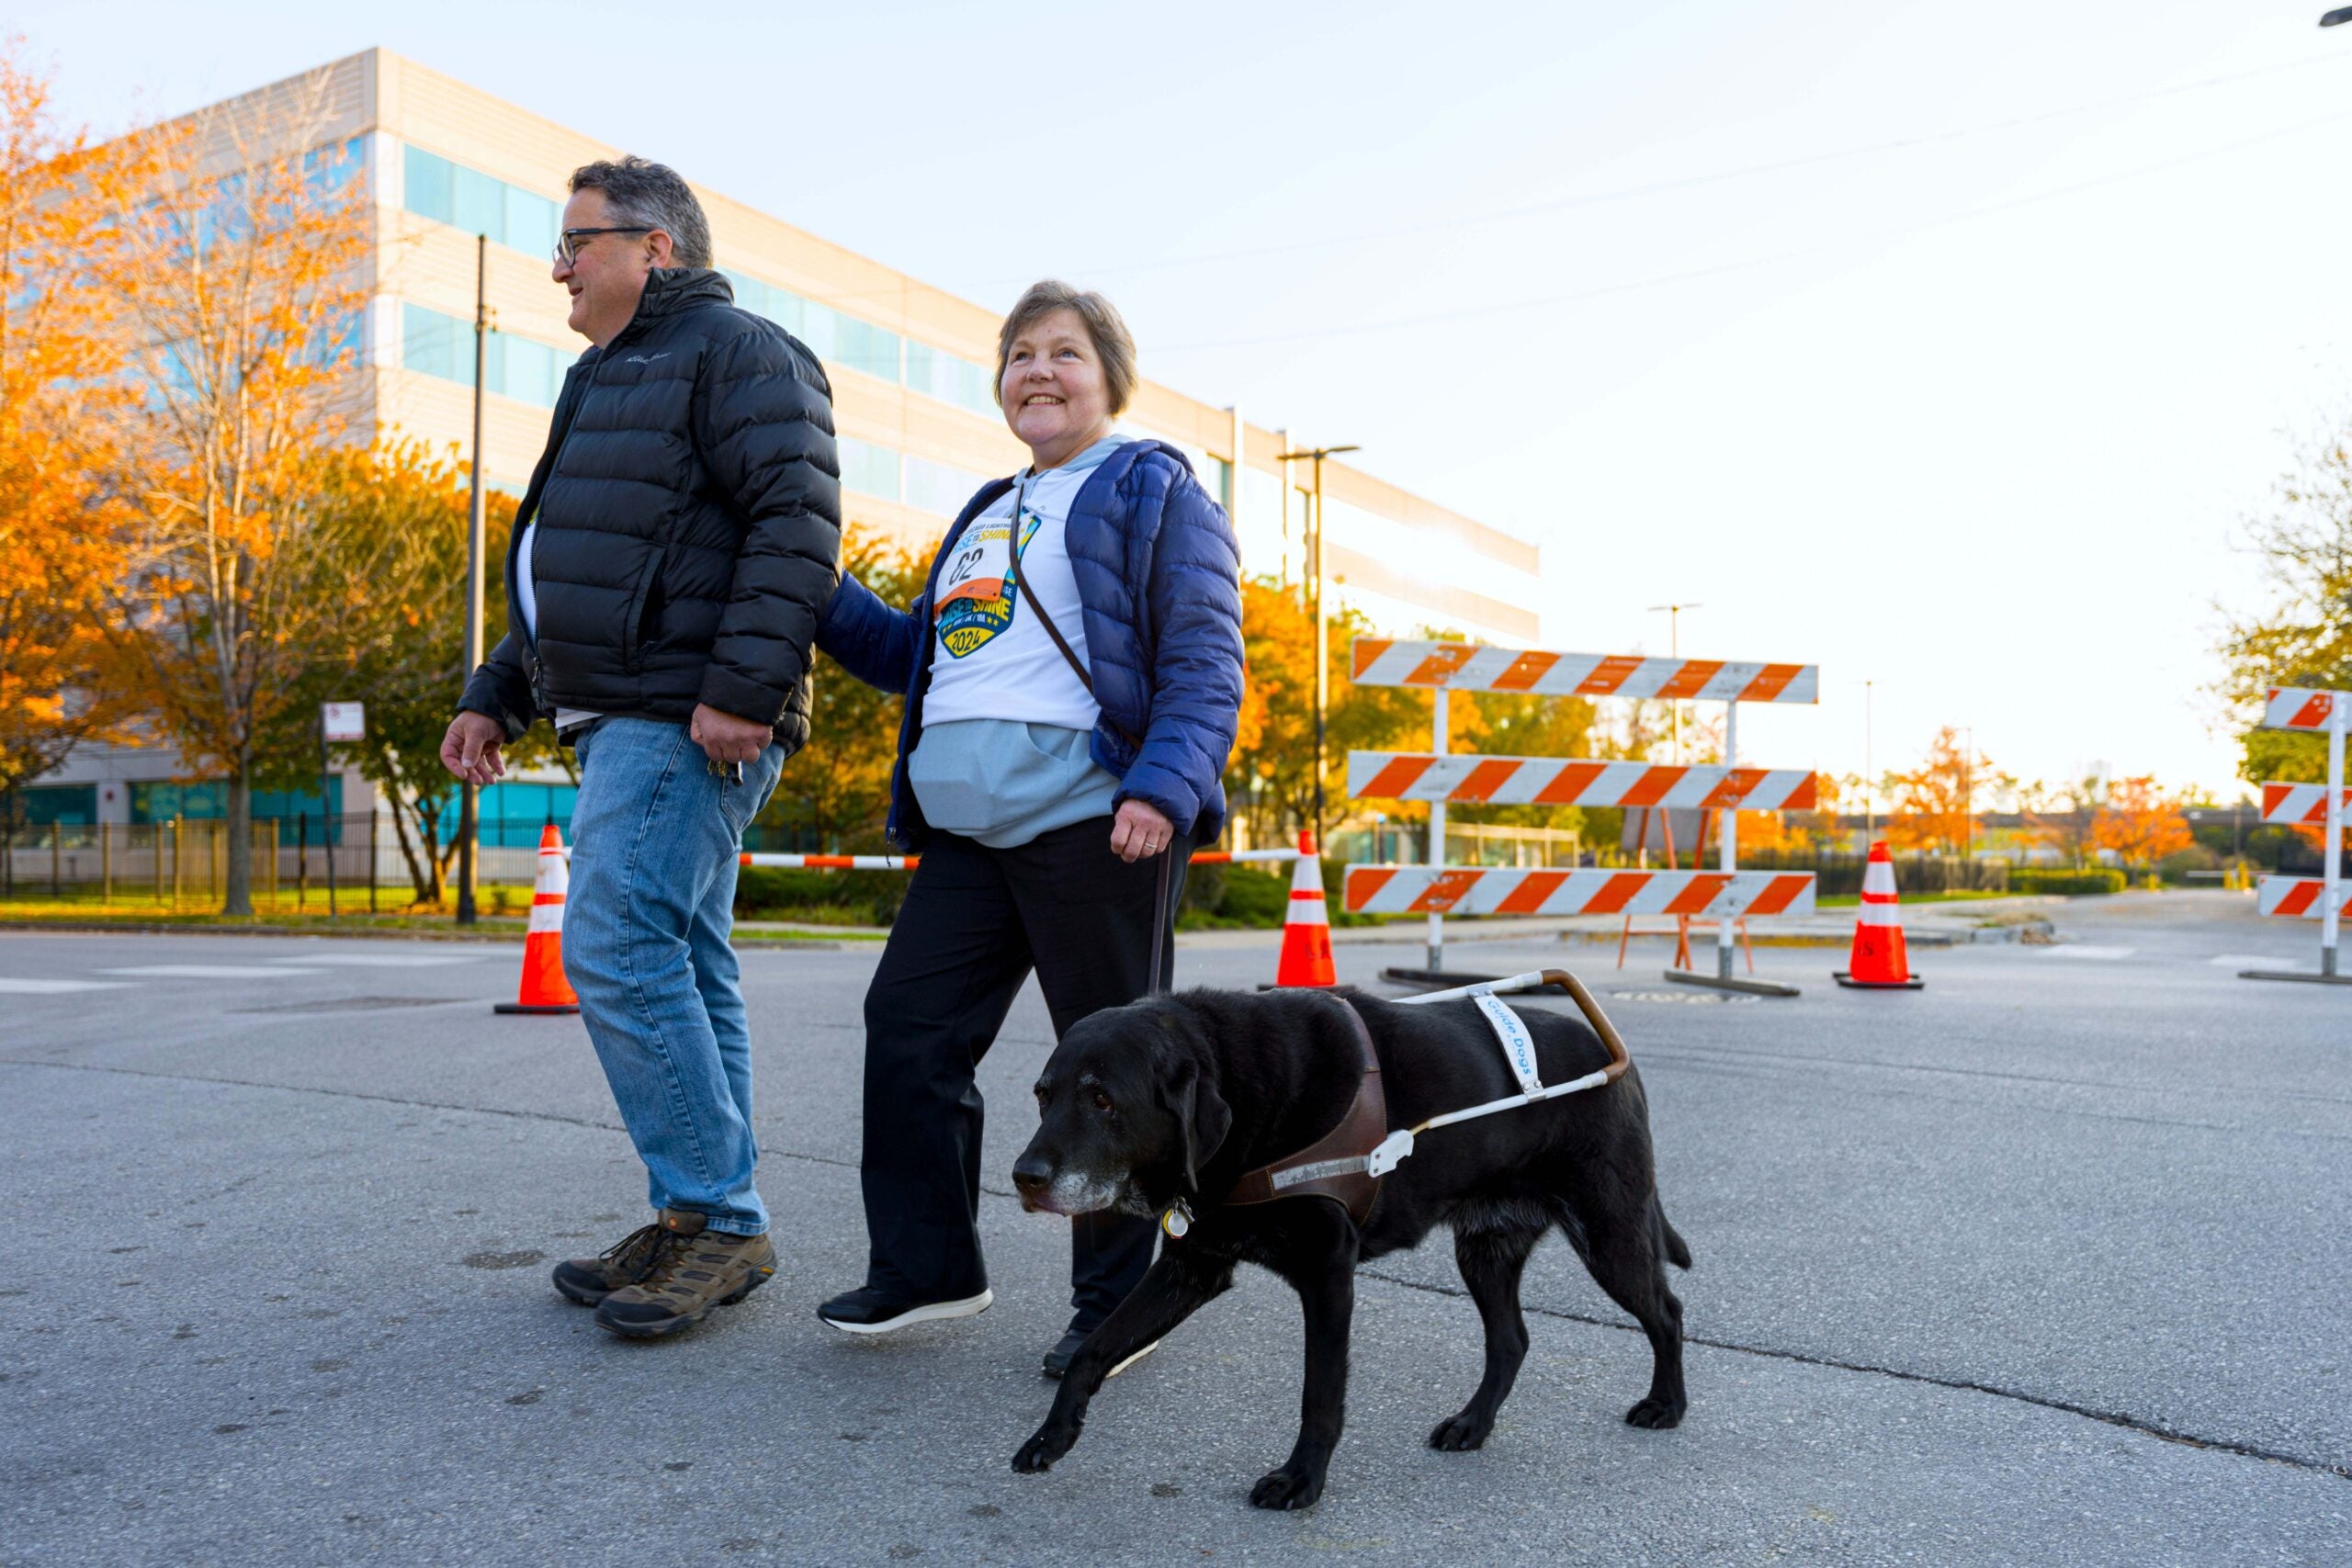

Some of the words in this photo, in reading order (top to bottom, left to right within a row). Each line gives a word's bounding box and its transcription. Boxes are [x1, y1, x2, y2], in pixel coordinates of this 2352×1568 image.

[978, 528, 1011, 543] SHIN
[952, 629, 980, 652] 2024
[1487, 999, 1517, 1034] Guide
[1513, 1037, 1532, 1076] Dogs
